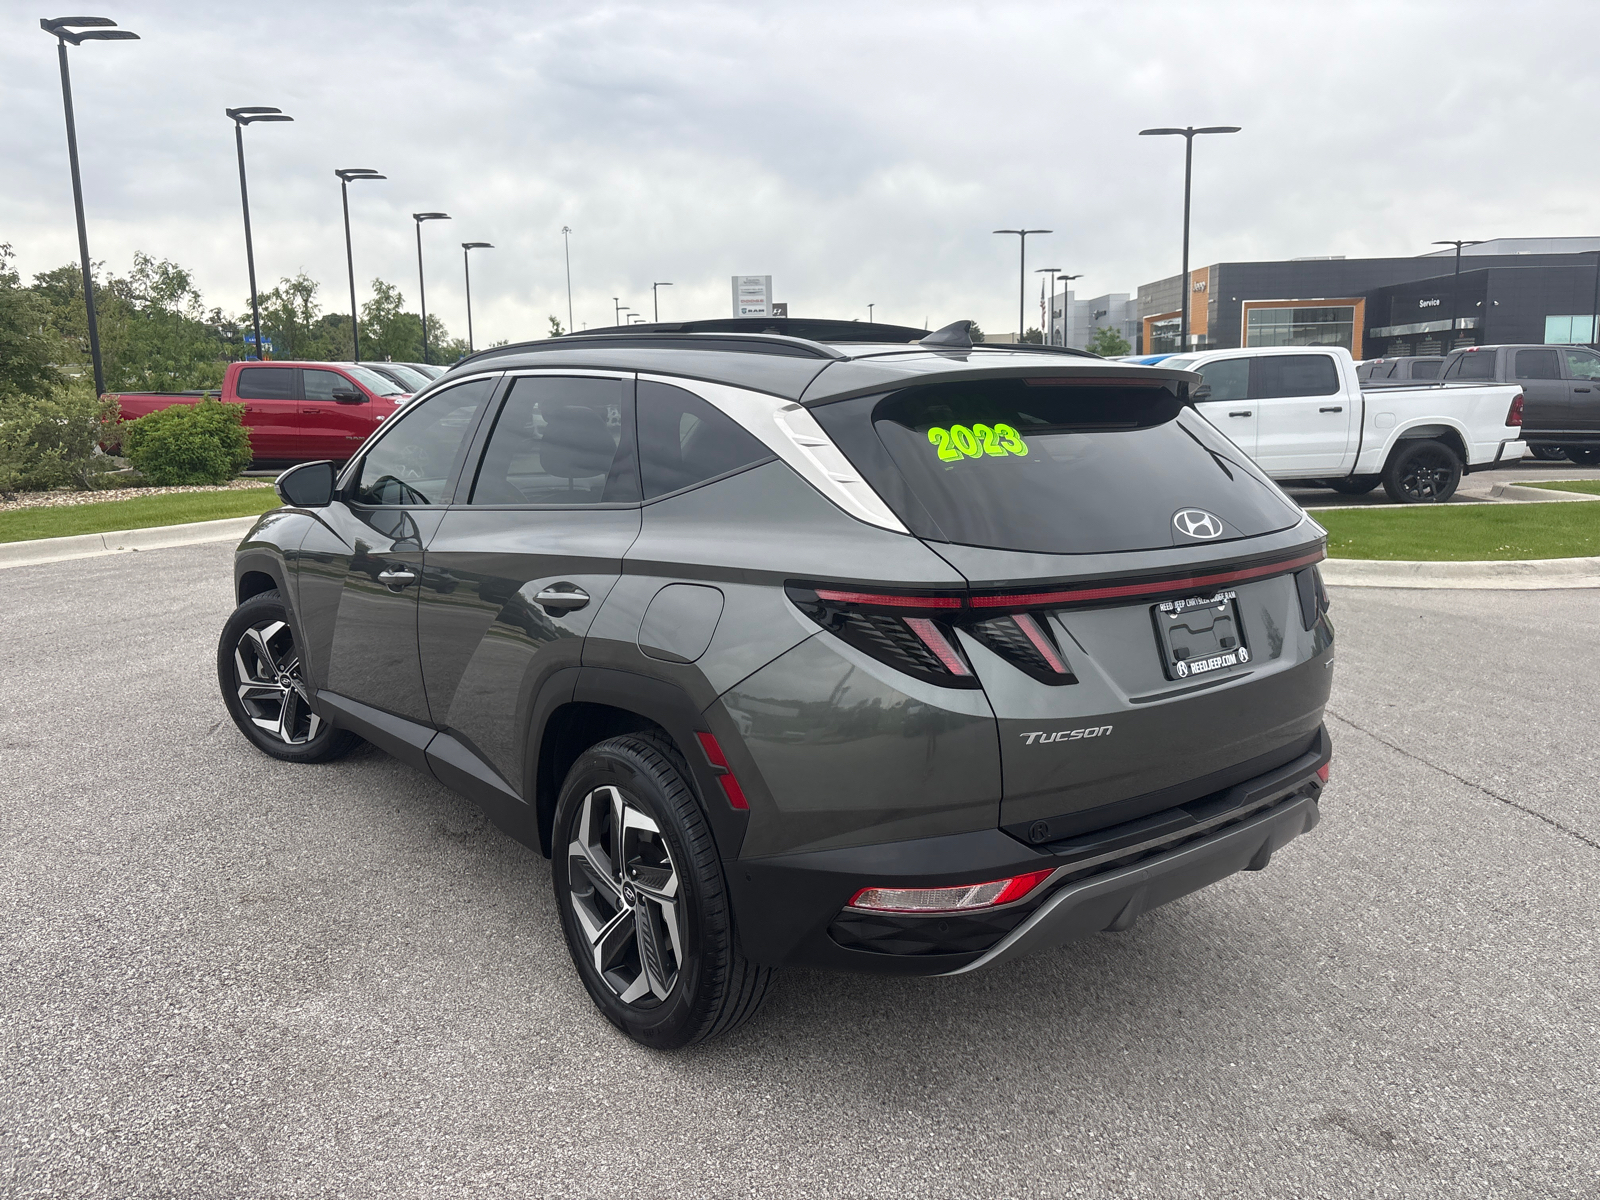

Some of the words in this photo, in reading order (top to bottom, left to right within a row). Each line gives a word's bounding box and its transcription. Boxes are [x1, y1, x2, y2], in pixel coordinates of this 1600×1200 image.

[1419, 298, 1440, 308] Service
[928, 423, 1029, 462] 2023
[1160, 602, 1174, 611] REED
[1174, 600, 1186, 609] JEEP
[1190, 654, 1237, 674] REEDJEEP.COM
